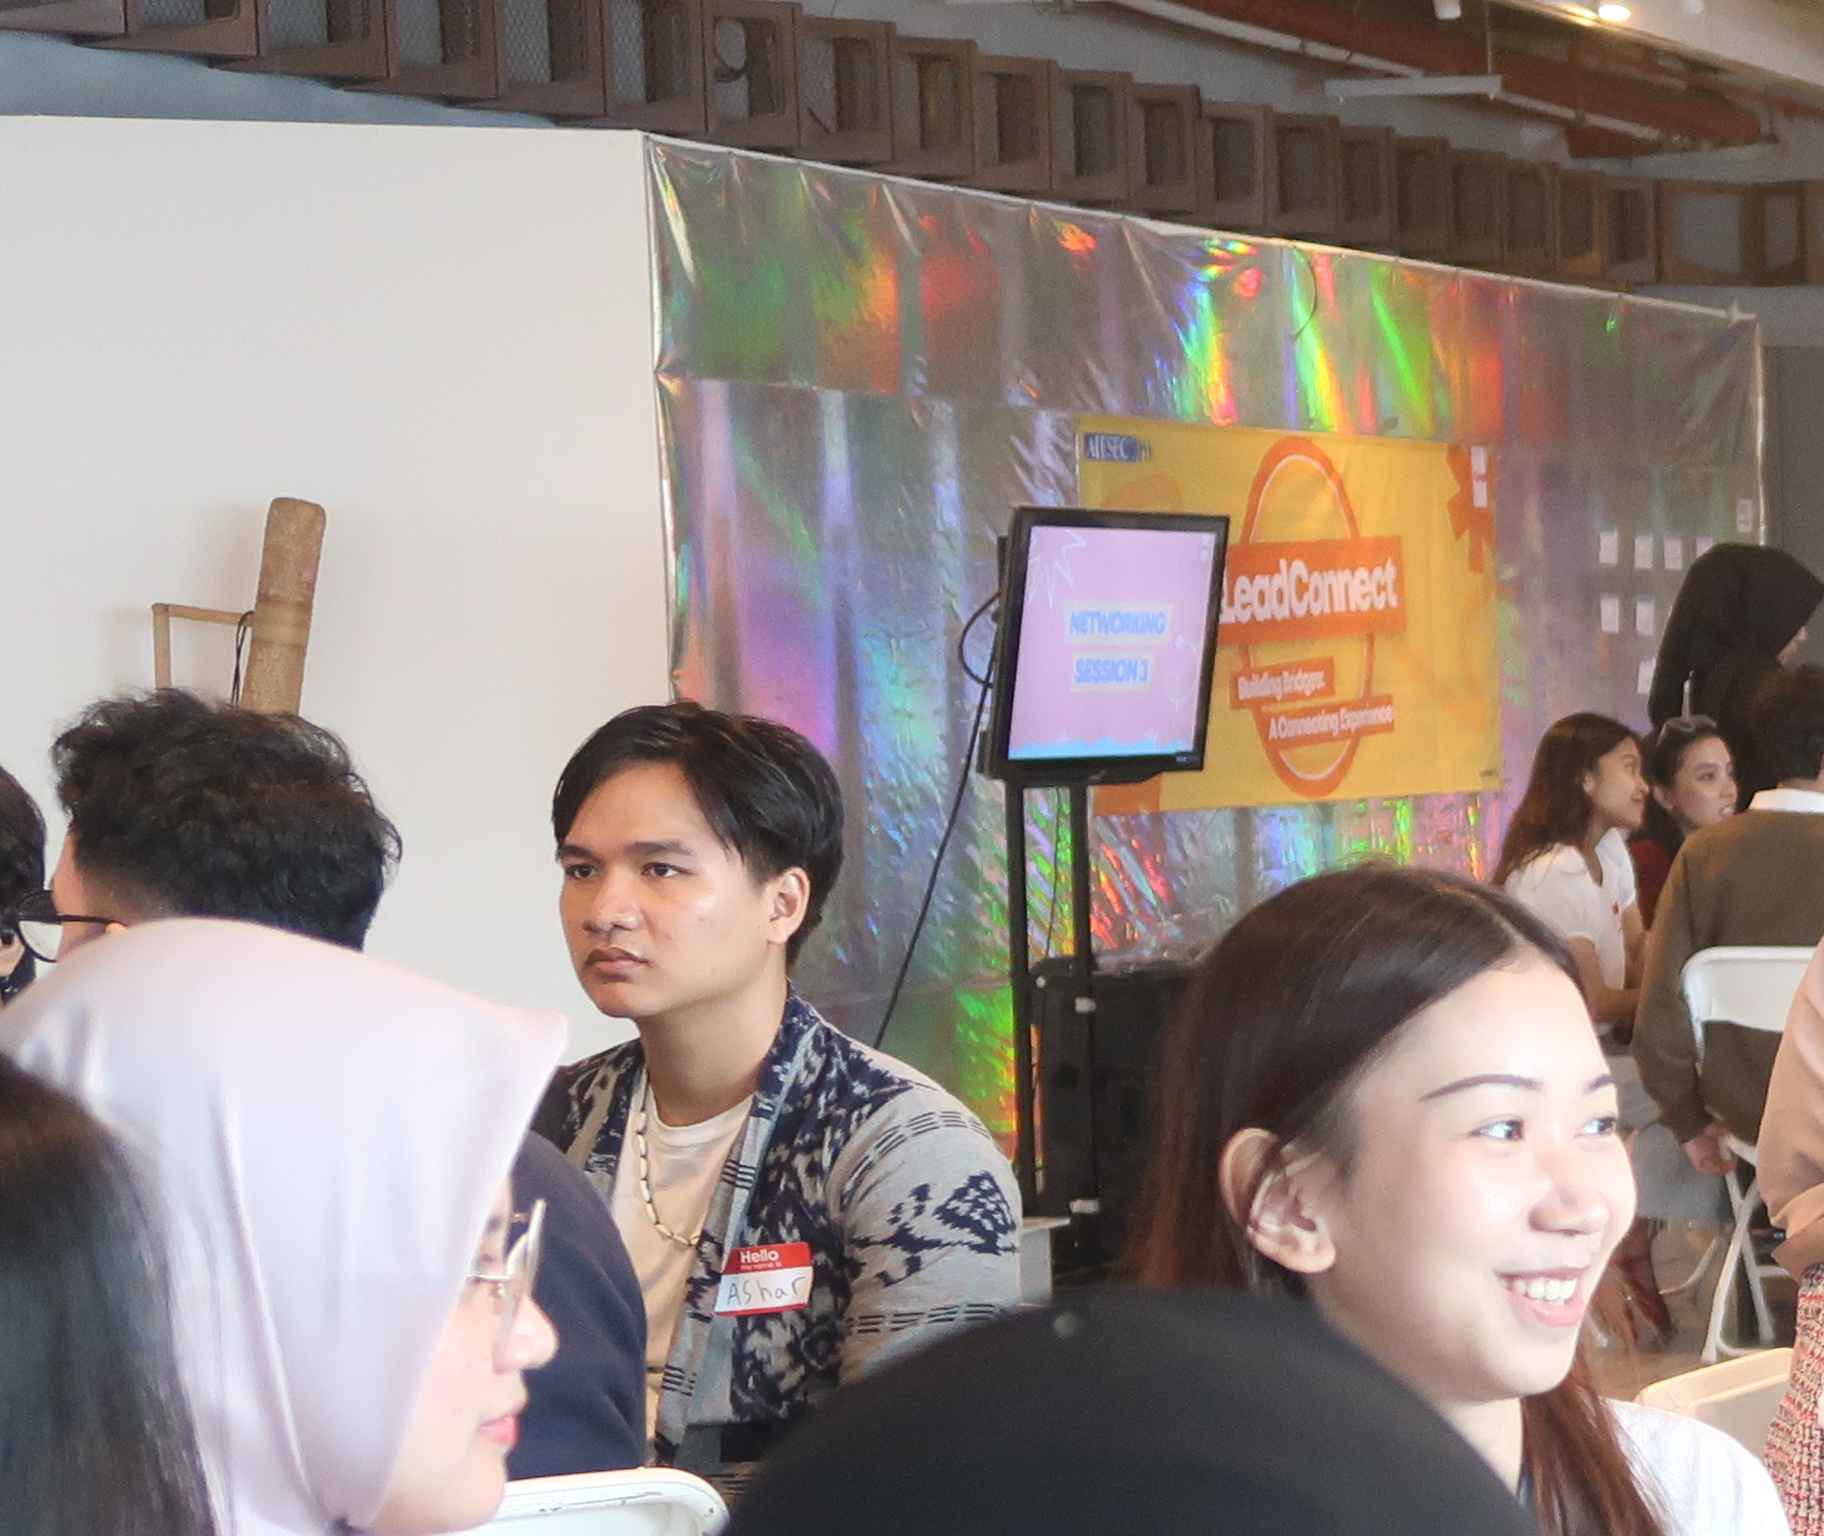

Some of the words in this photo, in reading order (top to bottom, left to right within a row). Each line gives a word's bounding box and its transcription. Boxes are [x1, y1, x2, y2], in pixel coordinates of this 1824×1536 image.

[1219, 559, 1397, 623] LeadConnect
[1070, 610, 1167, 636] NETWORKING
[1074, 657, 1138, 683] SESSION
[1268, 717, 1278, 740] A
[740, 1249, 779, 1264] Hello
